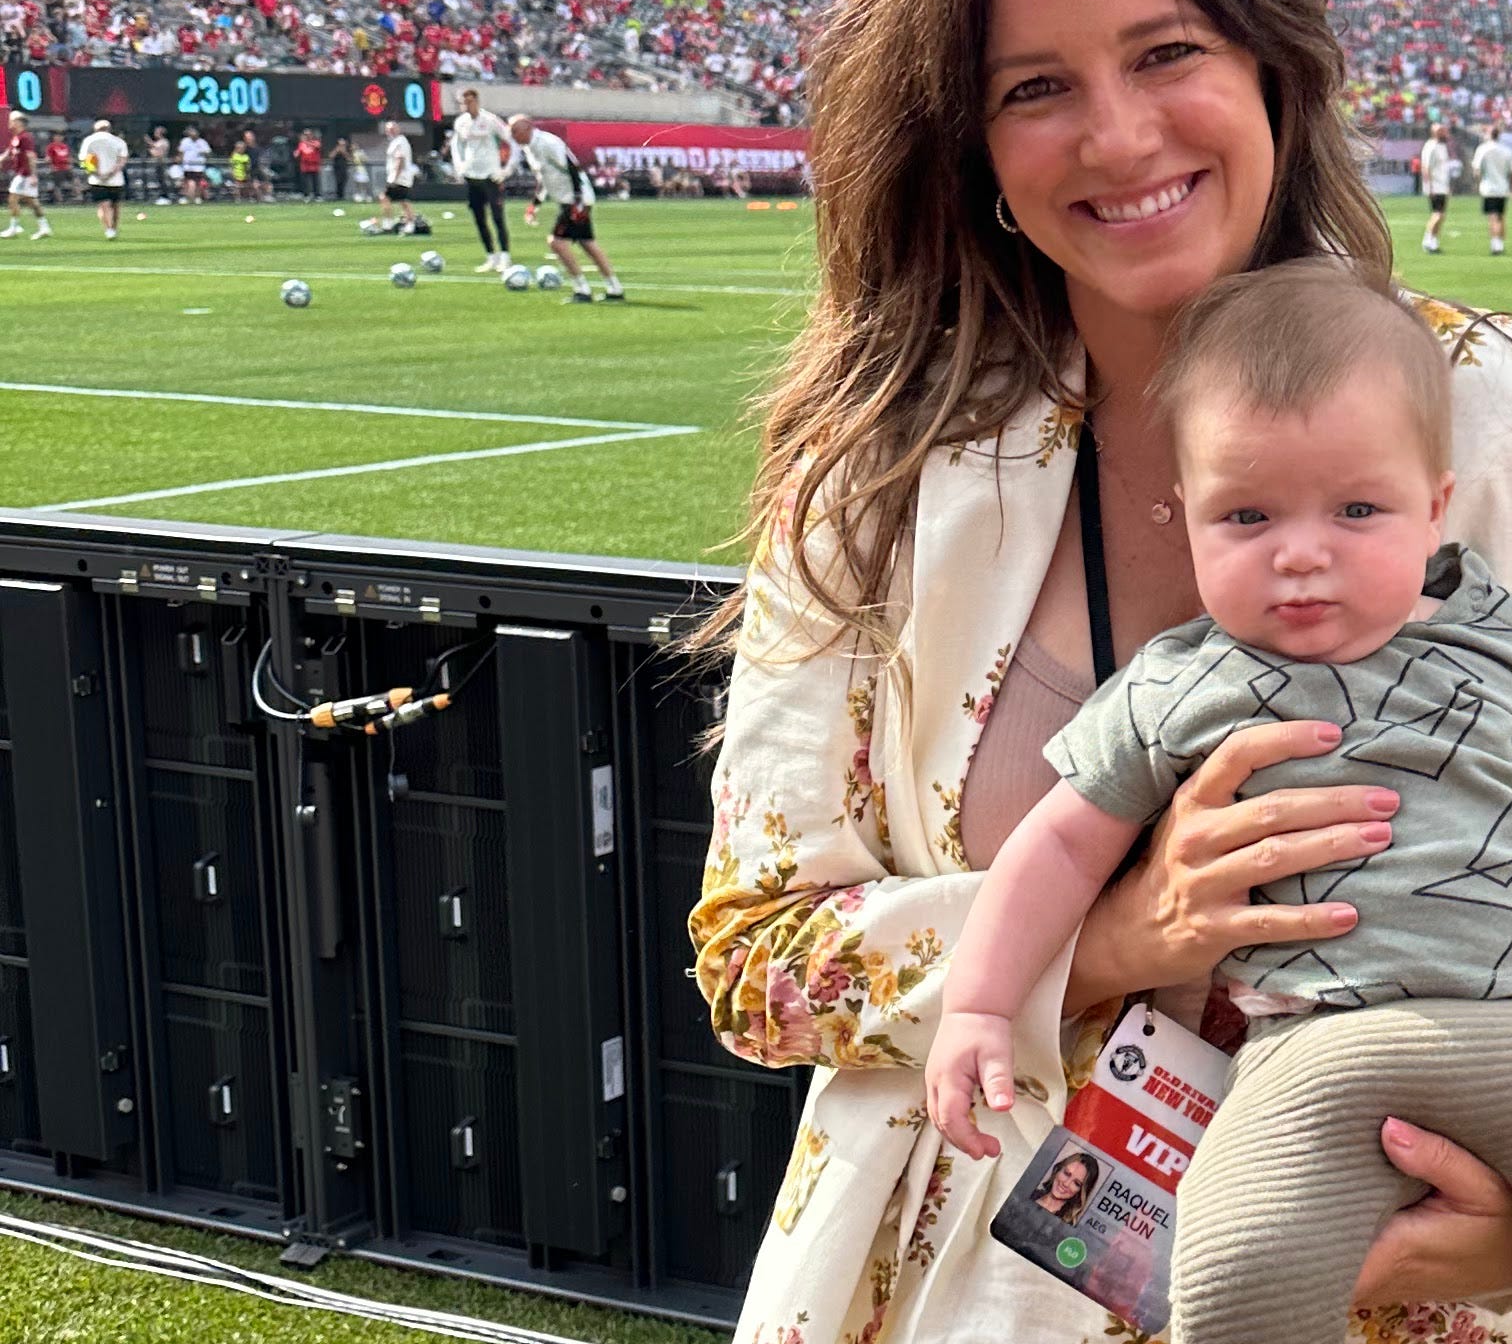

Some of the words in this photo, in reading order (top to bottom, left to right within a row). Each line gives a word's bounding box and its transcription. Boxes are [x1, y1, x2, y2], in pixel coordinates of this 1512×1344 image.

[17, 70, 42, 111] 0
[177, 75, 269, 116] 23:00
[404, 83, 426, 120] 0
[1142, 1075, 1184, 1110] NEW
[1183, 1099, 1216, 1129] YOR
[1153, 1066, 1182, 1087] OLD
[1181, 1083, 1219, 1112] RIVA
[1125, 1123, 1190, 1176] VIP
[1086, 1217, 1107, 1234] AEG
[1097, 1196, 1155, 1239] BRAUN
[1108, 1180, 1170, 1229] RAQUEL
